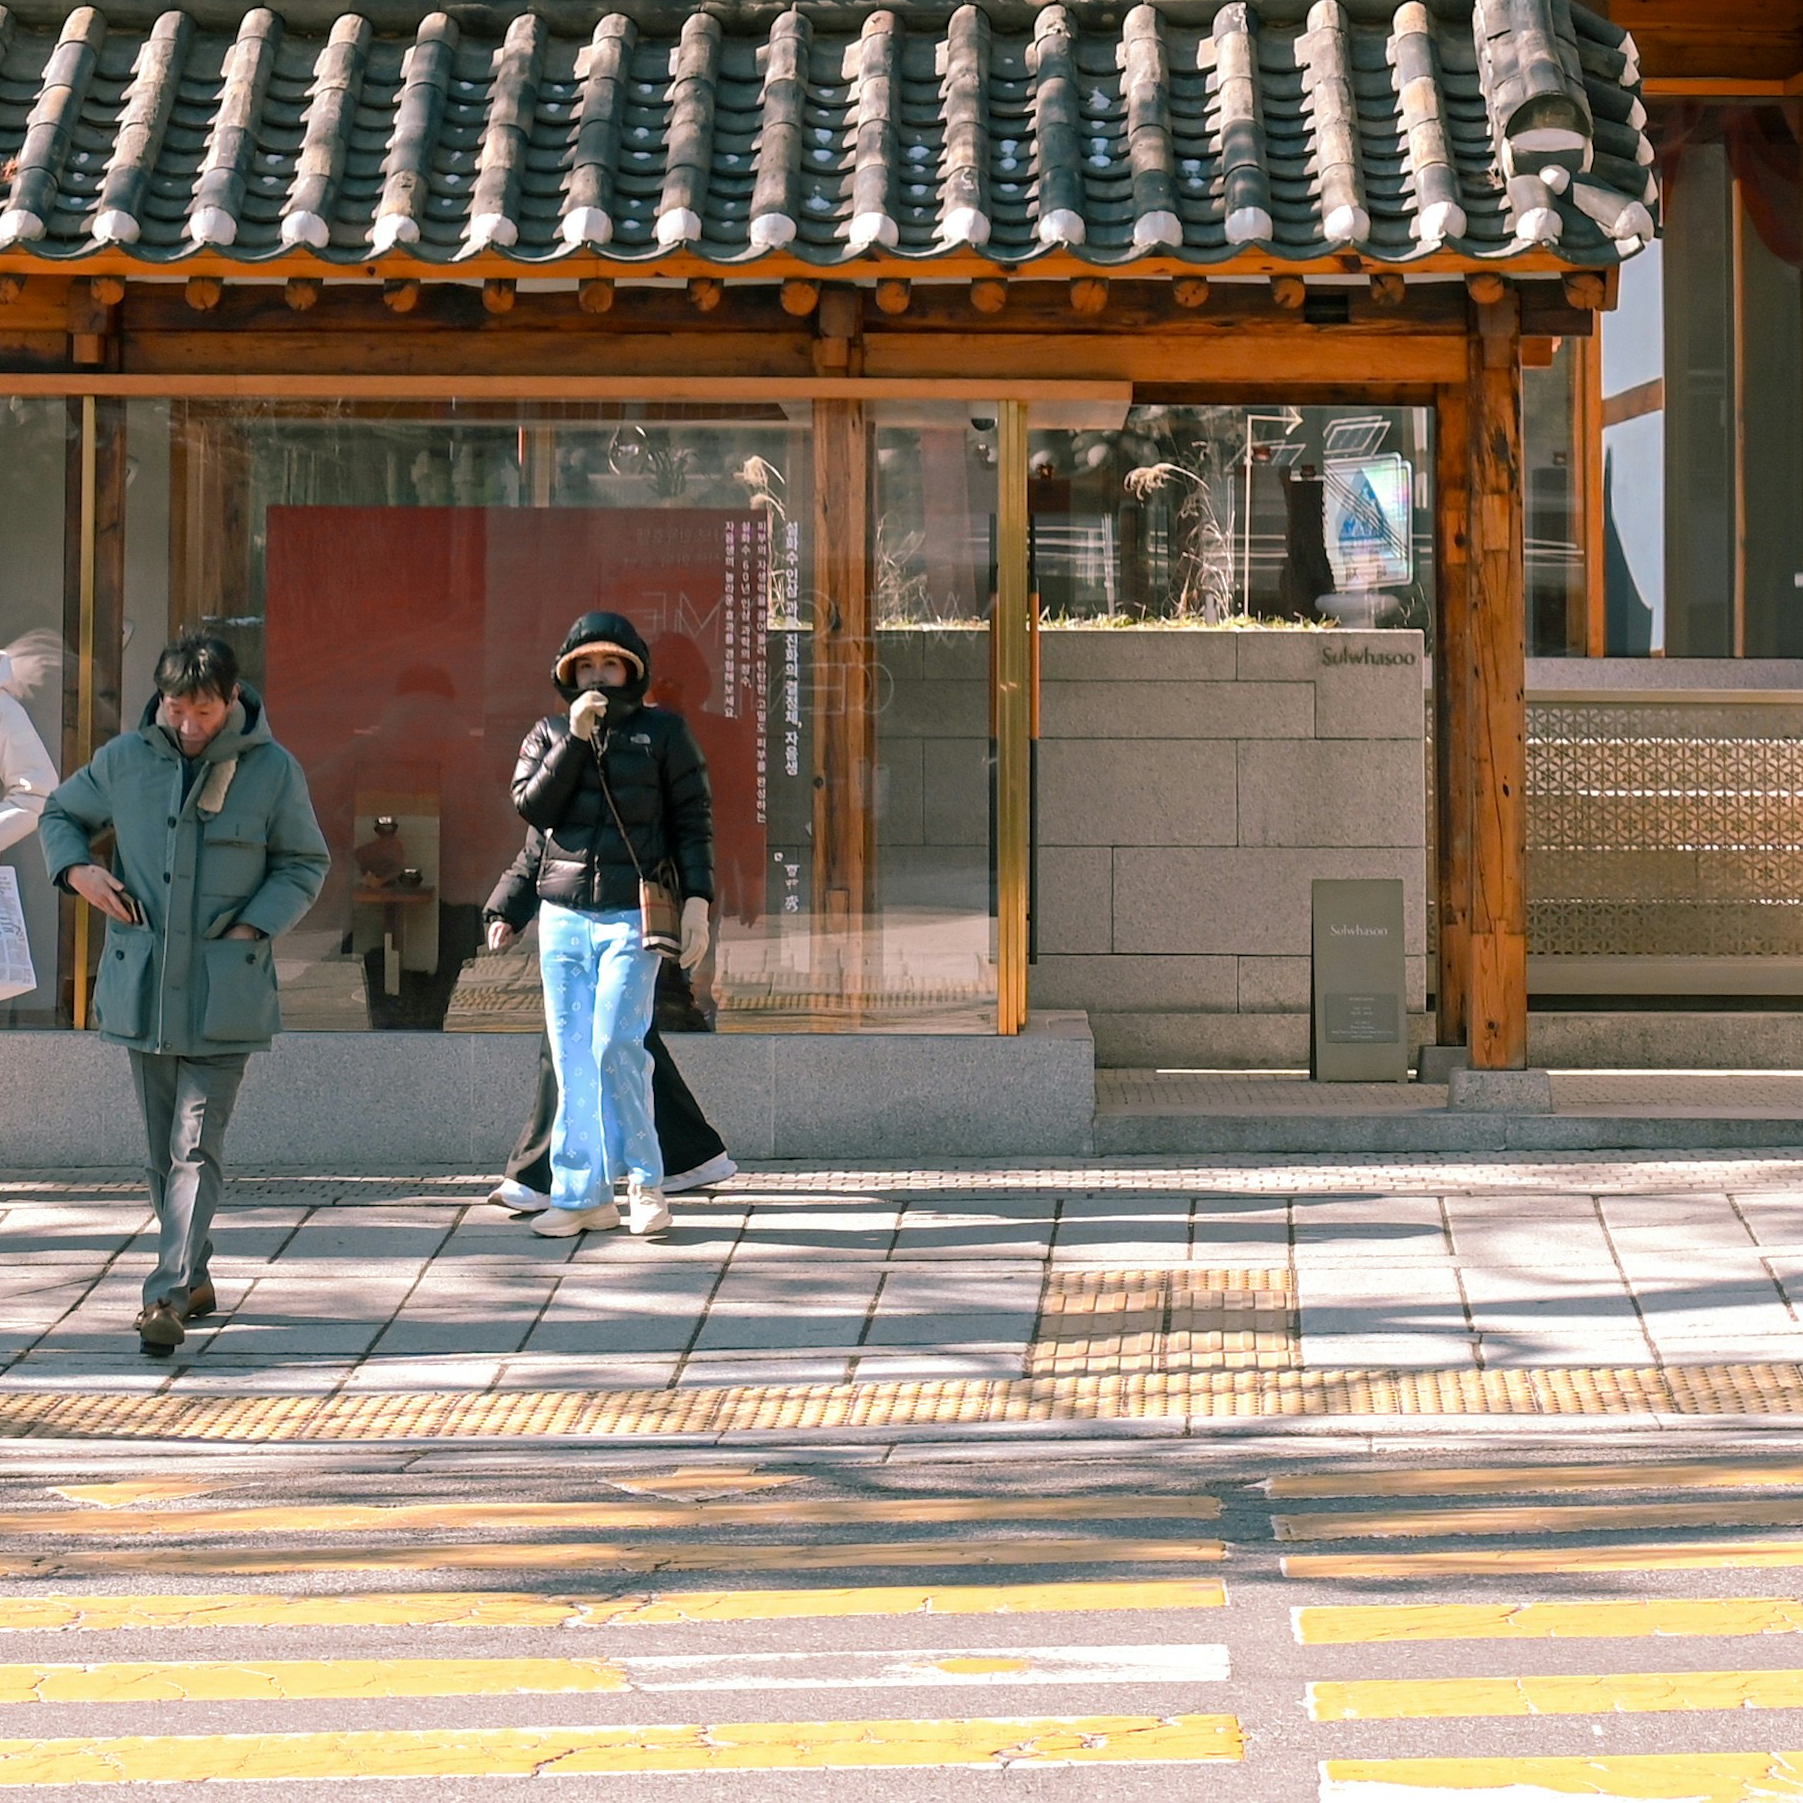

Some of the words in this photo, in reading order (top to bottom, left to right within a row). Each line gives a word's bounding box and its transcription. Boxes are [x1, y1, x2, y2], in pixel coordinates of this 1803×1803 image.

[741, 521, 751, 556] 설화수
[756, 521, 767, 556] 피부의
[785, 521, 799, 566] 설화수
[741, 560, 751, 595] 60년
[1321, 644, 1417, 667] Sulwhasoo
[756, 737, 767, 773] 피부를
[785, 730, 799, 776] 자음생
[756, 776, 767, 824] 완성하는
